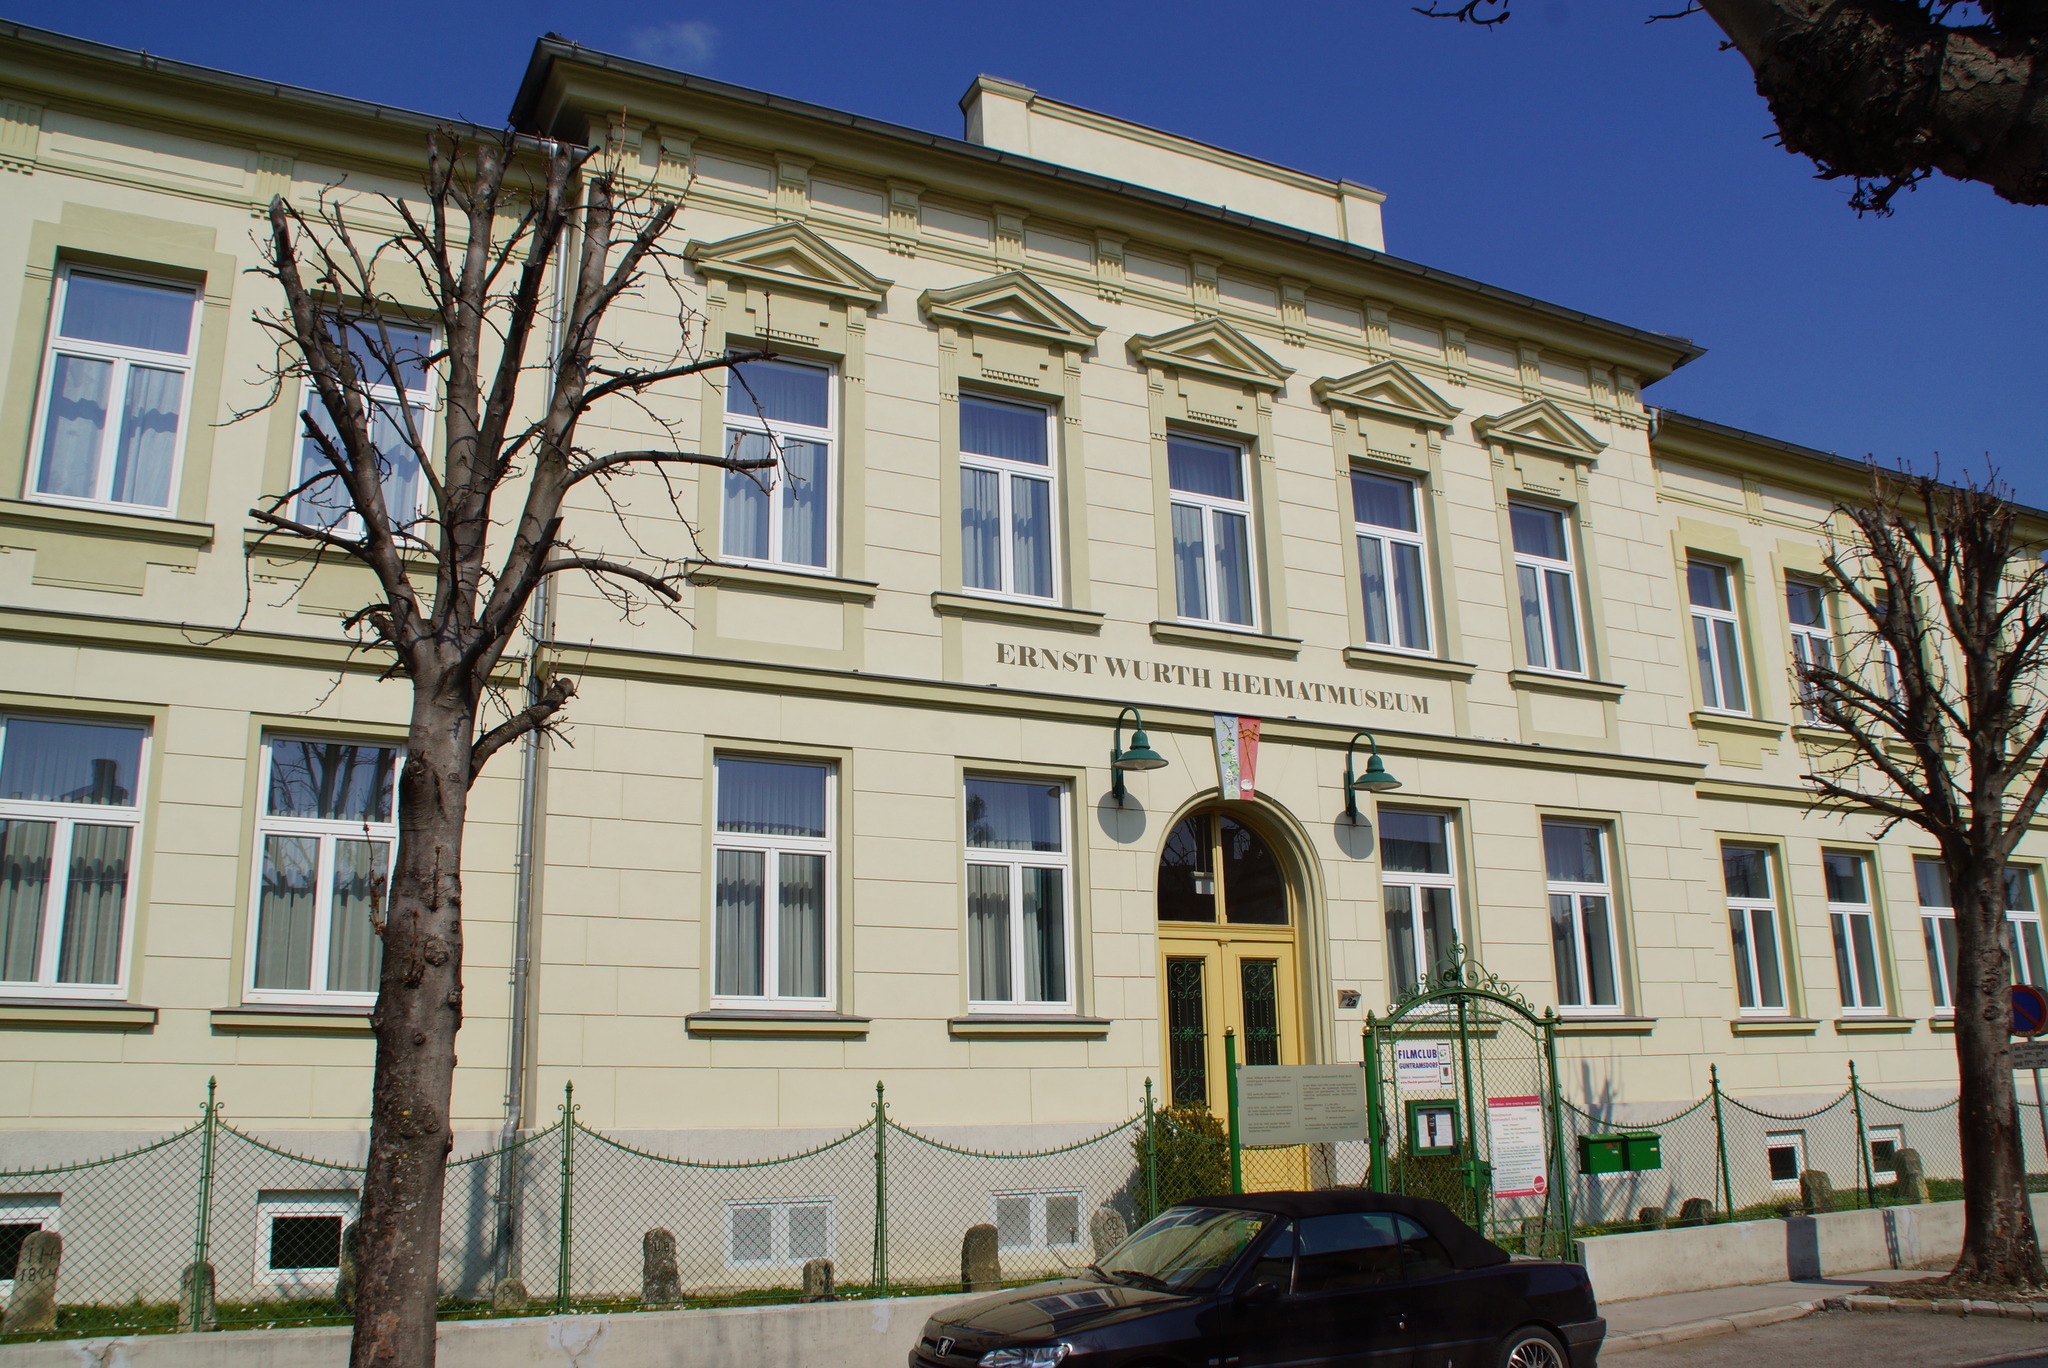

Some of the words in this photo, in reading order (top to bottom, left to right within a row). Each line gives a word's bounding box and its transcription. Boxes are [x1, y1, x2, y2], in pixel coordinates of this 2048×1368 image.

[995, 642, 1098, 675] ERNST
[1104, 656, 1213, 689] WURTH
[1221, 671, 1430, 714] HEIMATMUSEUM
[1398, 1049, 1438, 1059] FILMCLUB
